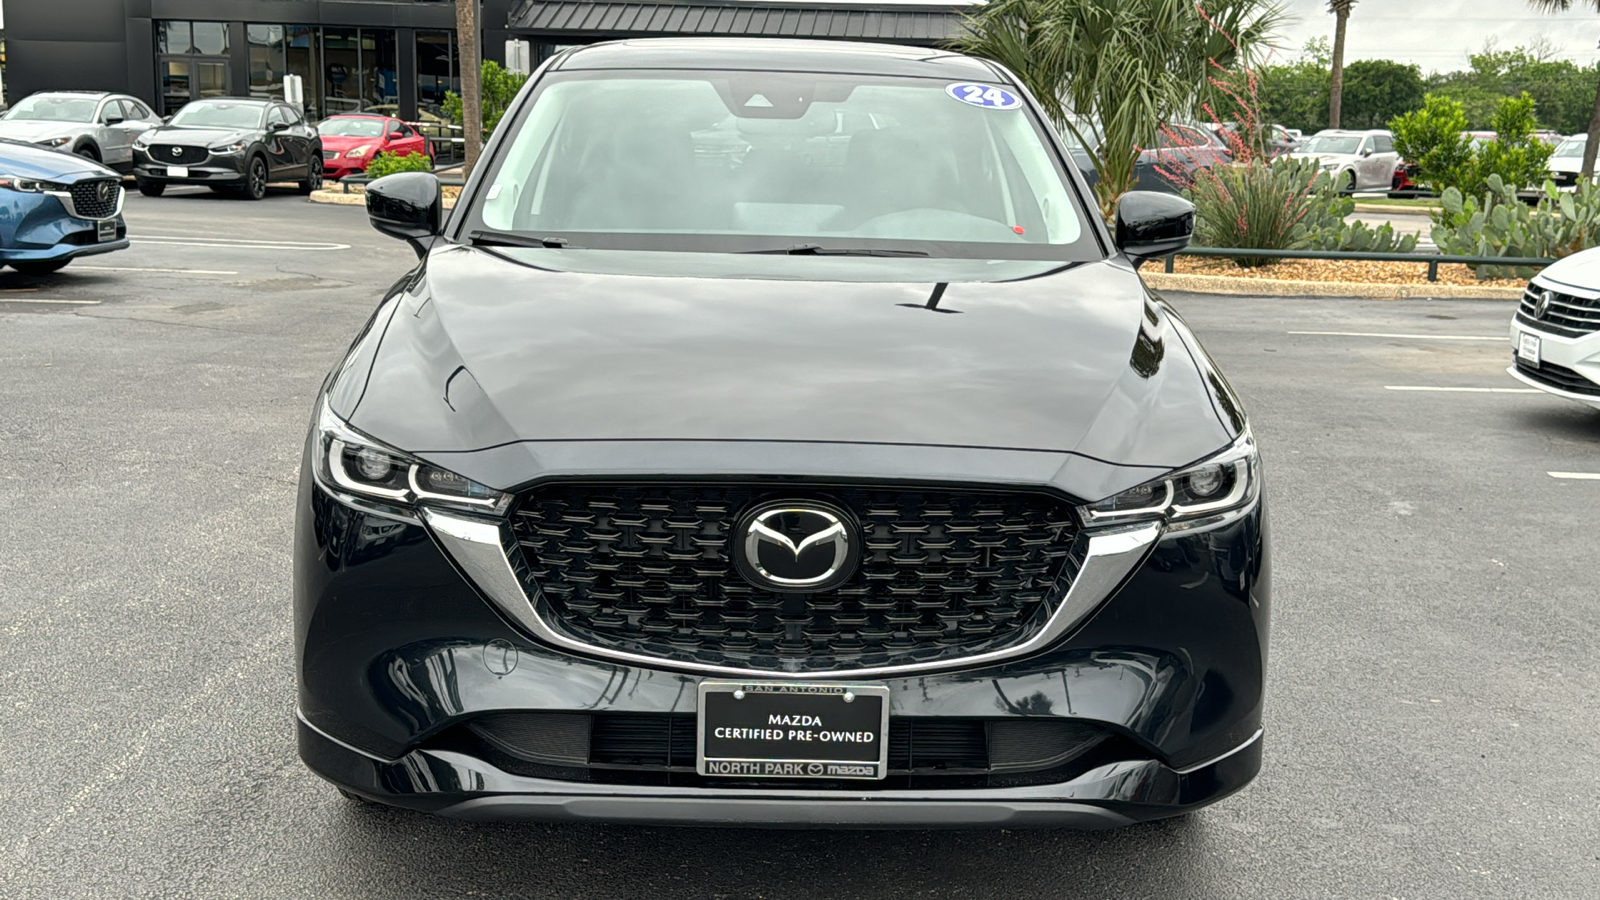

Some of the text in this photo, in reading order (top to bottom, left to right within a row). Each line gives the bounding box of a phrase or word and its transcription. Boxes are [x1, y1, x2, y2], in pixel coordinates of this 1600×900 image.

[962, 85, 1006, 107] 24
[745, 685, 844, 694] SAN ANTONIO
[768, 714, 822, 726] MAZDA
[714, 727, 874, 743] CERTIFIED PRE-OWNED
[708, 761, 874, 776] NORTH PARK mazda
